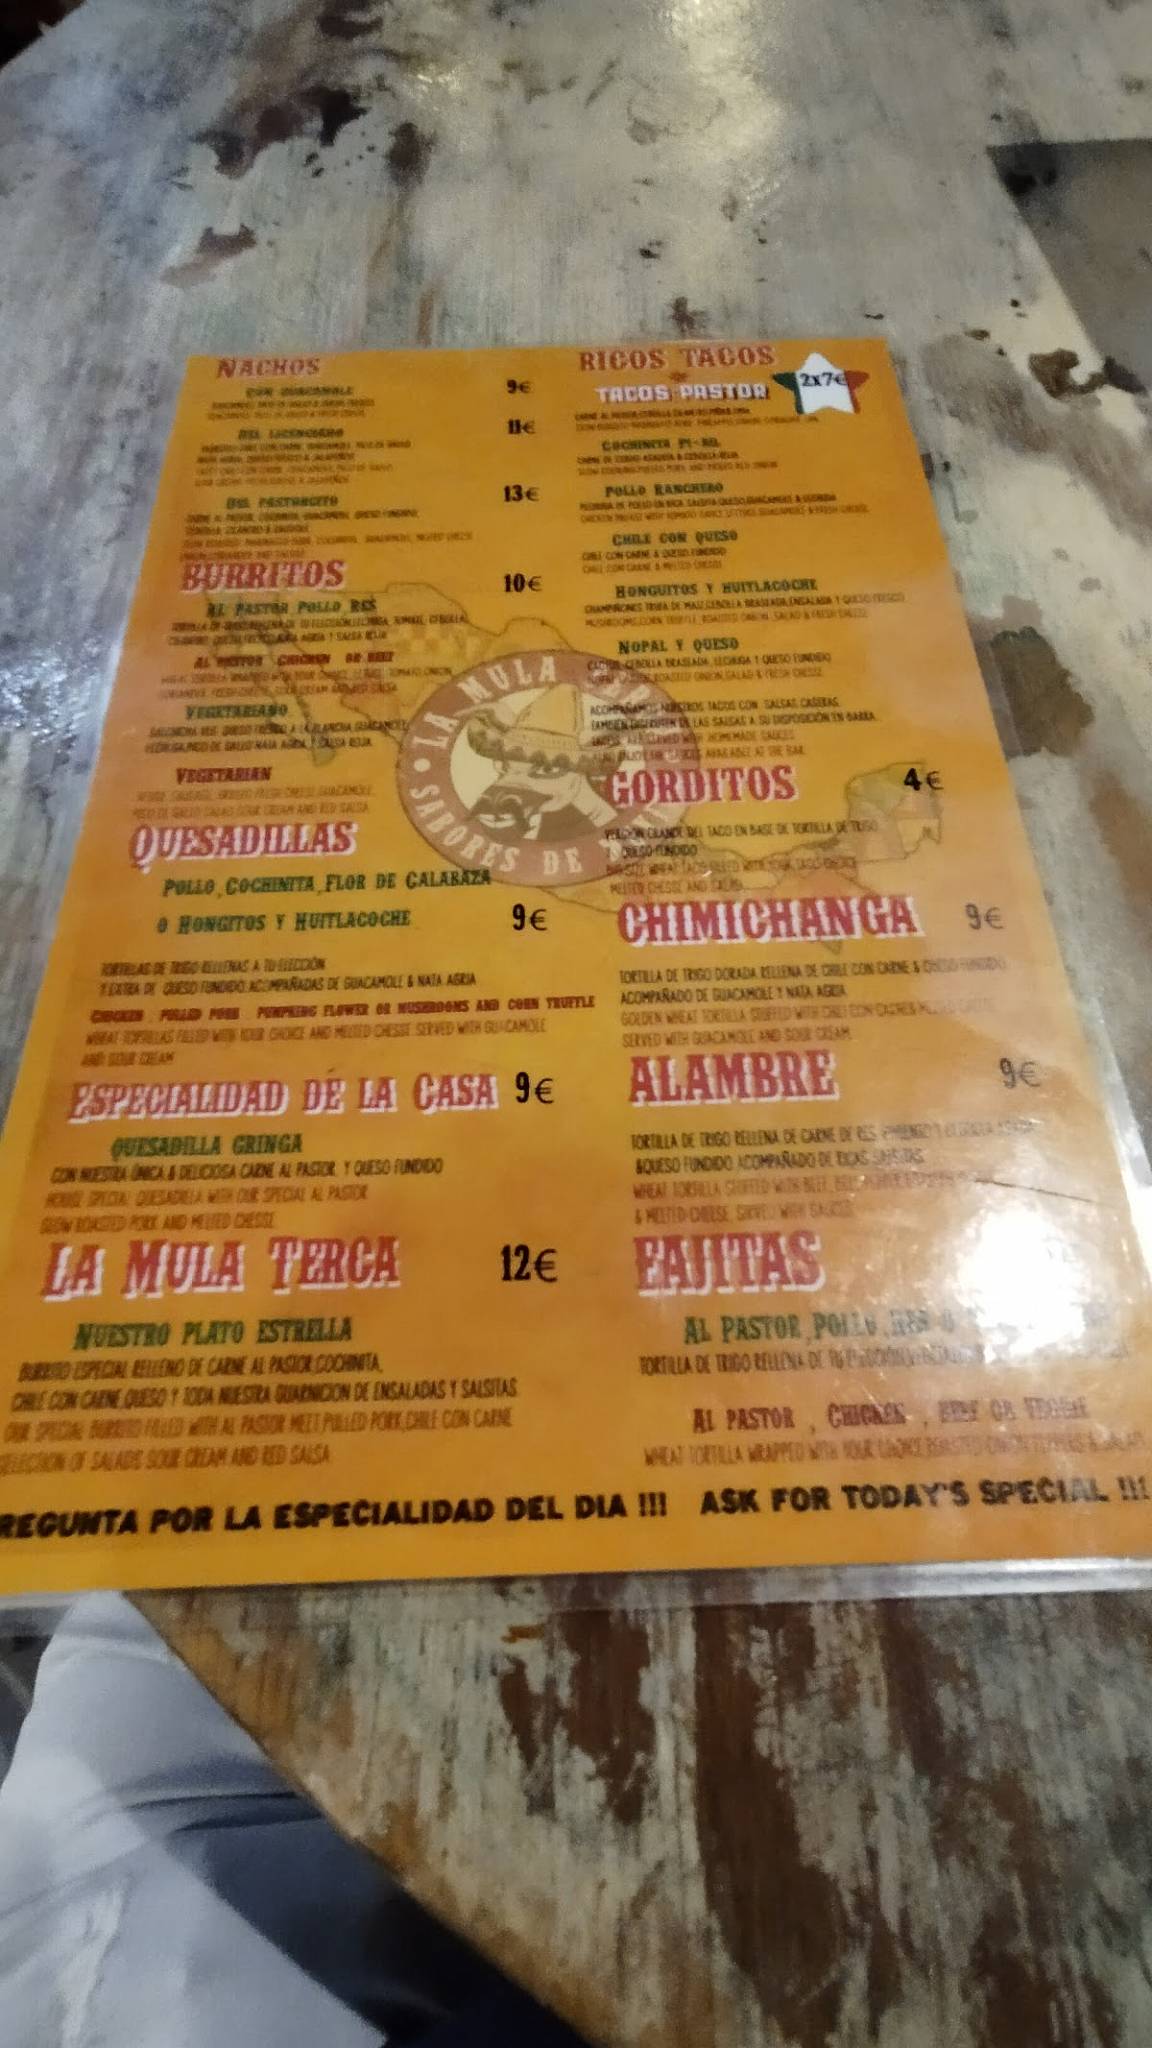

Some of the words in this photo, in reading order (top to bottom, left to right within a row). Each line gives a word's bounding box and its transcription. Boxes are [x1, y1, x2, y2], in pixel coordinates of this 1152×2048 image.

[216, 358, 320, 378] NACHOS
[580, 350, 667, 371] RICOS
[679, 346, 777, 367] TACOS
[506, 379, 532, 394] 9€
[596, 386, 672, 402] TACOS
[679, 383, 770, 401] PASTOR
[503, 485, 540, 502] 13€
[605, 485, 646, 498] POLLO
[654, 483, 724, 496] RANCHERO
[659, 531, 687, 544] CON
[696, 530, 738, 545] QUESO
[180, 560, 347, 592] BURRITOS
[503, 573, 542, 592] 10€
[615, 584, 698, 599] HONGUITOS
[619, 640, 668, 654] NOPAL
[693, 637, 739, 653] QUESO
[457, 656, 556, 703] MULA
[609, 766, 799, 808] GORDITOS
[409, 783, 520, 873] SABORES
[544, 848, 582, 875] DE
[131, 821, 358, 874] QUESADILLAS
[325, 873, 366, 893] FLOR
[376, 872, 396, 889] DE
[406, 869, 491, 890] CALABAZA
[178, 914, 266, 935] HONGITOS
[276, 913, 286, 930] Y
[295, 910, 411, 931] HUITLACOCHE
[512, 903, 547, 931] 9€
[617, 896, 926, 948] CHIMICHANGA
[965, 902, 1004, 930] 9€
[619, 970, 662, 984] TORTILLA
[666, 969, 677, 982] DE
[621, 988, 691, 1006] ACOMPAÑADO
[695, 988, 708, 1002] DE
[629, 1050, 839, 1107] ALAMBRE
[999, 1057, 1041, 1088] 9€
[68, 1080, 288, 1123] ESPECIALIDAD
[358, 1076, 398, 1112] LA
[414, 1072, 500, 1114] CASA
[515, 1071, 554, 1104] 9€
[111, 1136, 221, 1162] QUESADILLA
[232, 1133, 303, 1155] GRINGA
[631, 1134, 677, 1149] TORTILLA
[681, 1133, 695, 1148] DE
[239, 1162, 274, 1178] CARNE
[278, 1162, 292, 1178] AL
[354, 1159, 390, 1177] QUESO
[394, 1158, 444, 1175] FUNDIDO
[41, 1240, 104, 1301] LA
[121, 1238, 245, 1300] MULA
[268, 1236, 402, 1295] TERCA
[501, 1244, 557, 1282] 12€
[73, 1321, 171, 1350] NUESTRO
[181, 1320, 245, 1346] PLATO
[256, 1317, 353, 1344] ESTRELLA
[684, 1316, 712, 1344] AL
[721, 1314, 801, 1343] PASTOR
[188, 1357, 204, 1377] DE
[207, 1355, 248, 1376] CARNE
[251, 1355, 265, 1375] AL
[639, 1356, 692, 1376] TORTILLA
[695, 1354, 712, 1374] DE
[716, 1354, 750, 1373] TRIGO
[807, 1351, 823, 1370] DE
[354, 1381, 370, 1402] DE
[374, 1379, 446, 1401] ENSALADAS
[450, 1380, 457, 1399] Y
[461, 1377, 518, 1399] SALSITAS
[222, 1415, 235, 1435] AL
[474, 1407, 512, 1428] CARNE
[693, 1408, 716, 1434] AL
[727, 1406, 795, 1430] PASTOR
[700, 1488, 759, 1517] ASK
[771, 1486, 833, 1514] FOR
[841, 1479, 970, 1510] TODAY'S
[978, 1477, 1109, 1507] SPECIAL
[150, 1506, 213, 1534] POR
[224, 1504, 262, 1532] LA
[273, 1497, 494, 1531] ESPECIALIDAD
[504, 1496, 563, 1523] DEL
[575, 1494, 629, 1520] DIA
[637, 1492, 668, 1518] !!!
